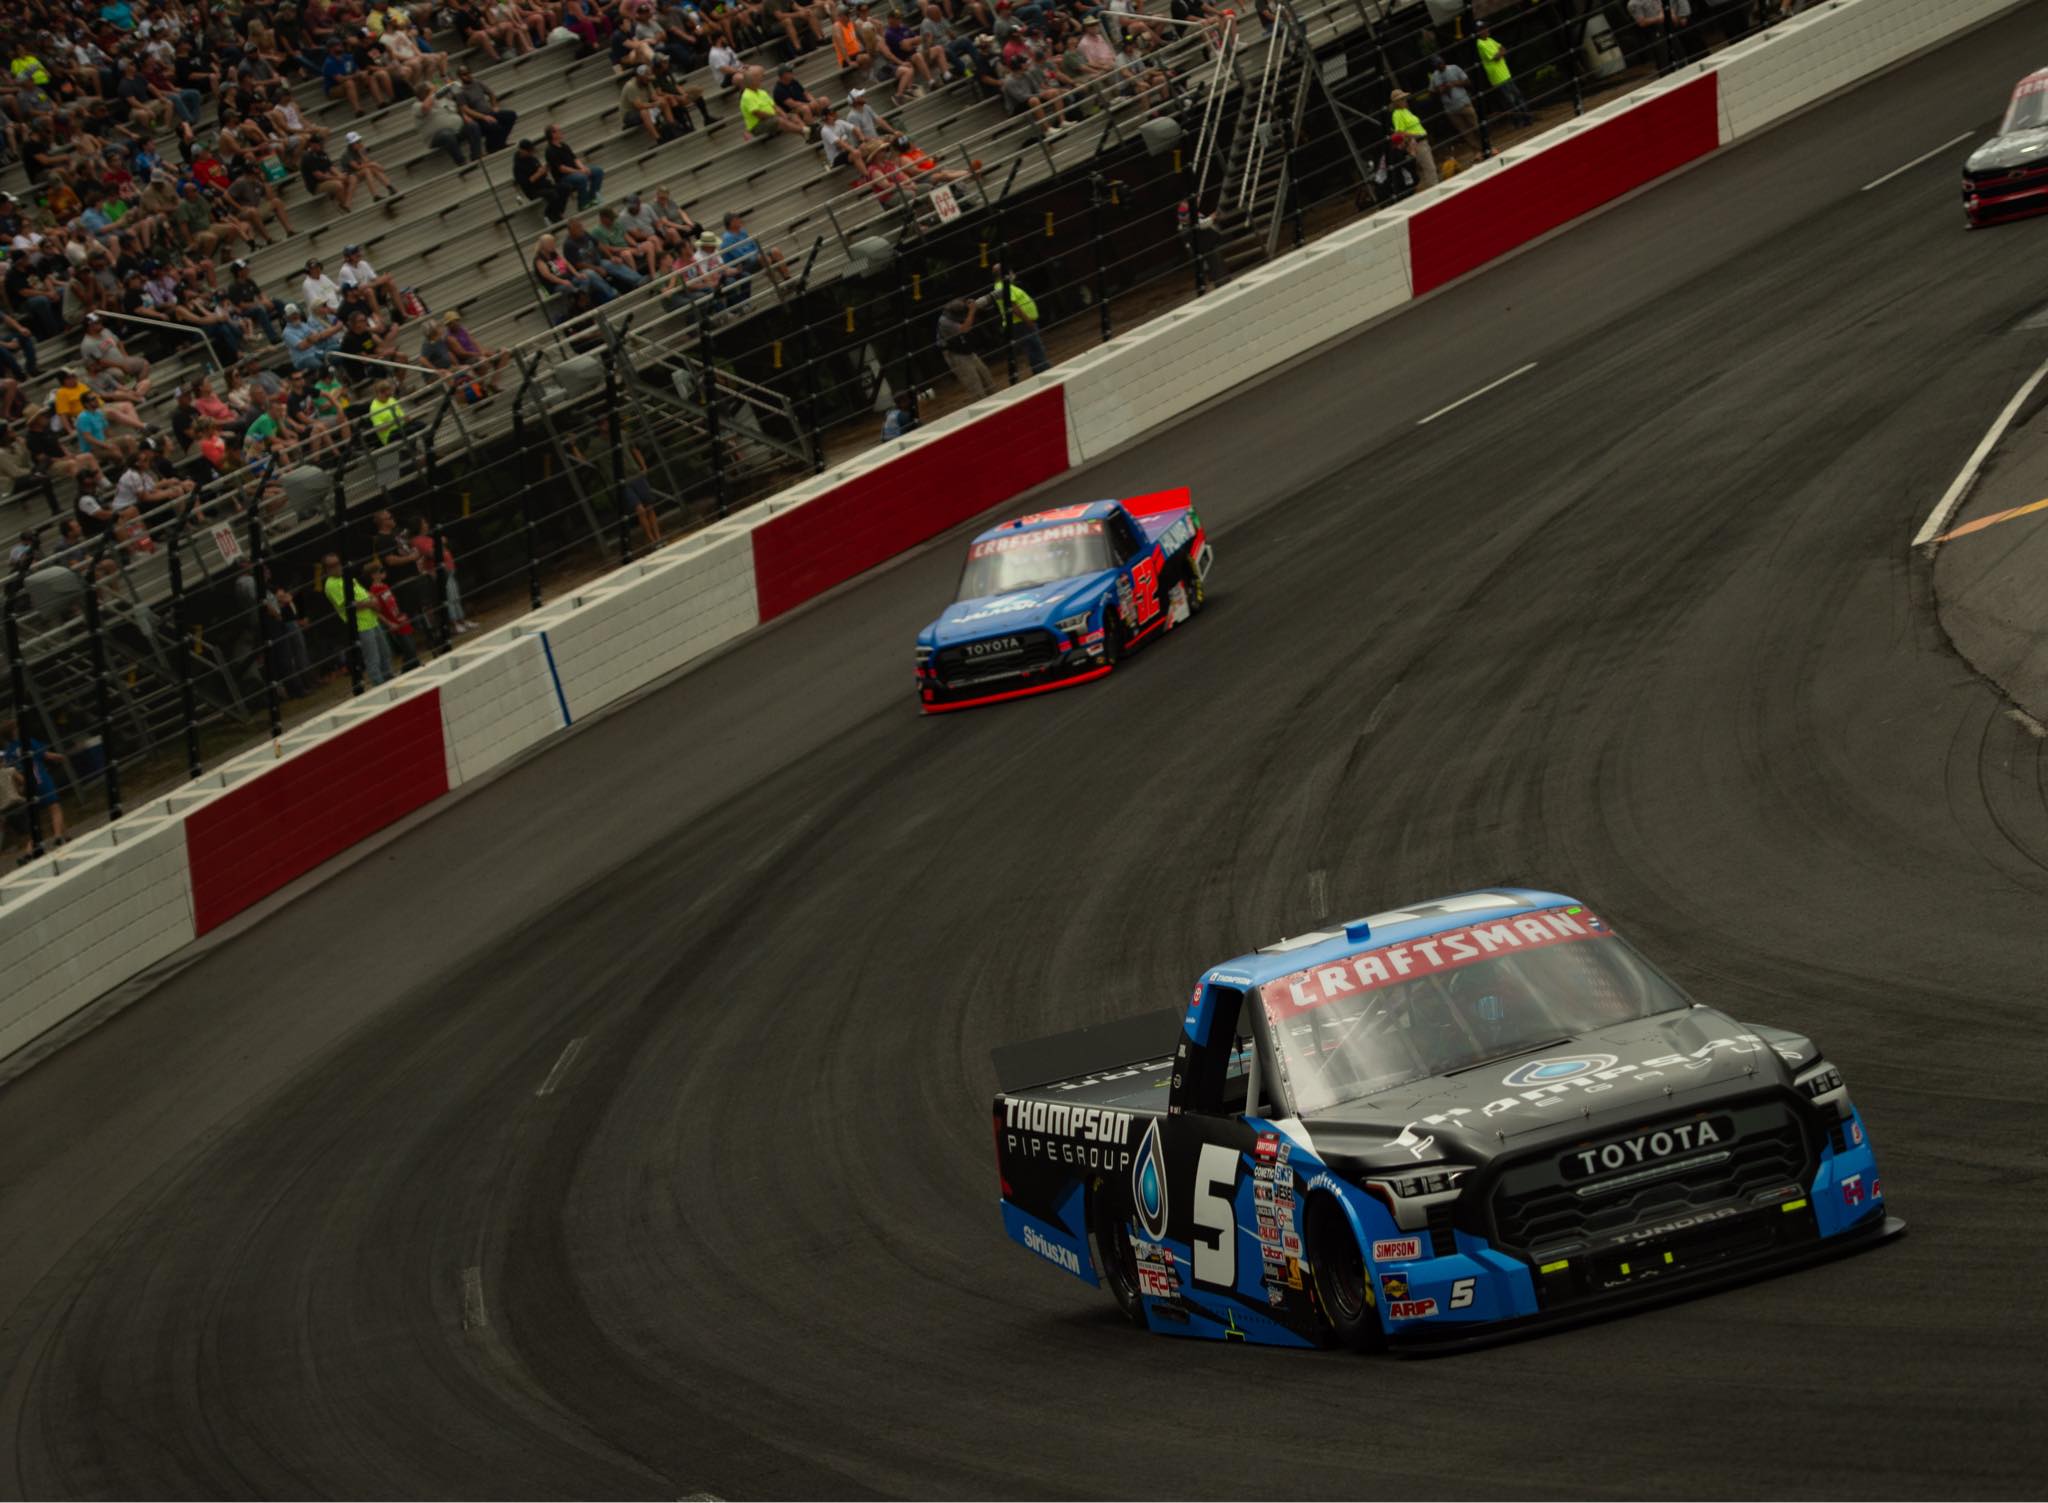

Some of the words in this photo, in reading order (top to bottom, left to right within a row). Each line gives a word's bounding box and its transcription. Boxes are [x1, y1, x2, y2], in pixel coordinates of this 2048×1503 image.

[975, 523, 1090, 559] CRAFTSMAN
[966, 637, 1020, 656] TOYOTA
[1289, 912, 1587, 1006] CRAFTSMAN
[1004, 1097, 1130, 1145] THOMPSON
[1577, 1120, 1720, 1175] TOYOTA
[1193, 1142, 1241, 1288] 5
[1610, 1207, 1738, 1244] TUNDRA
[1023, 1225, 1080, 1275] SiriusXM
[1376, 1242, 1415, 1258] SIMPSON
[1391, 1300, 1435, 1317] ARP
[1449, 1277, 1476, 1309] 5
